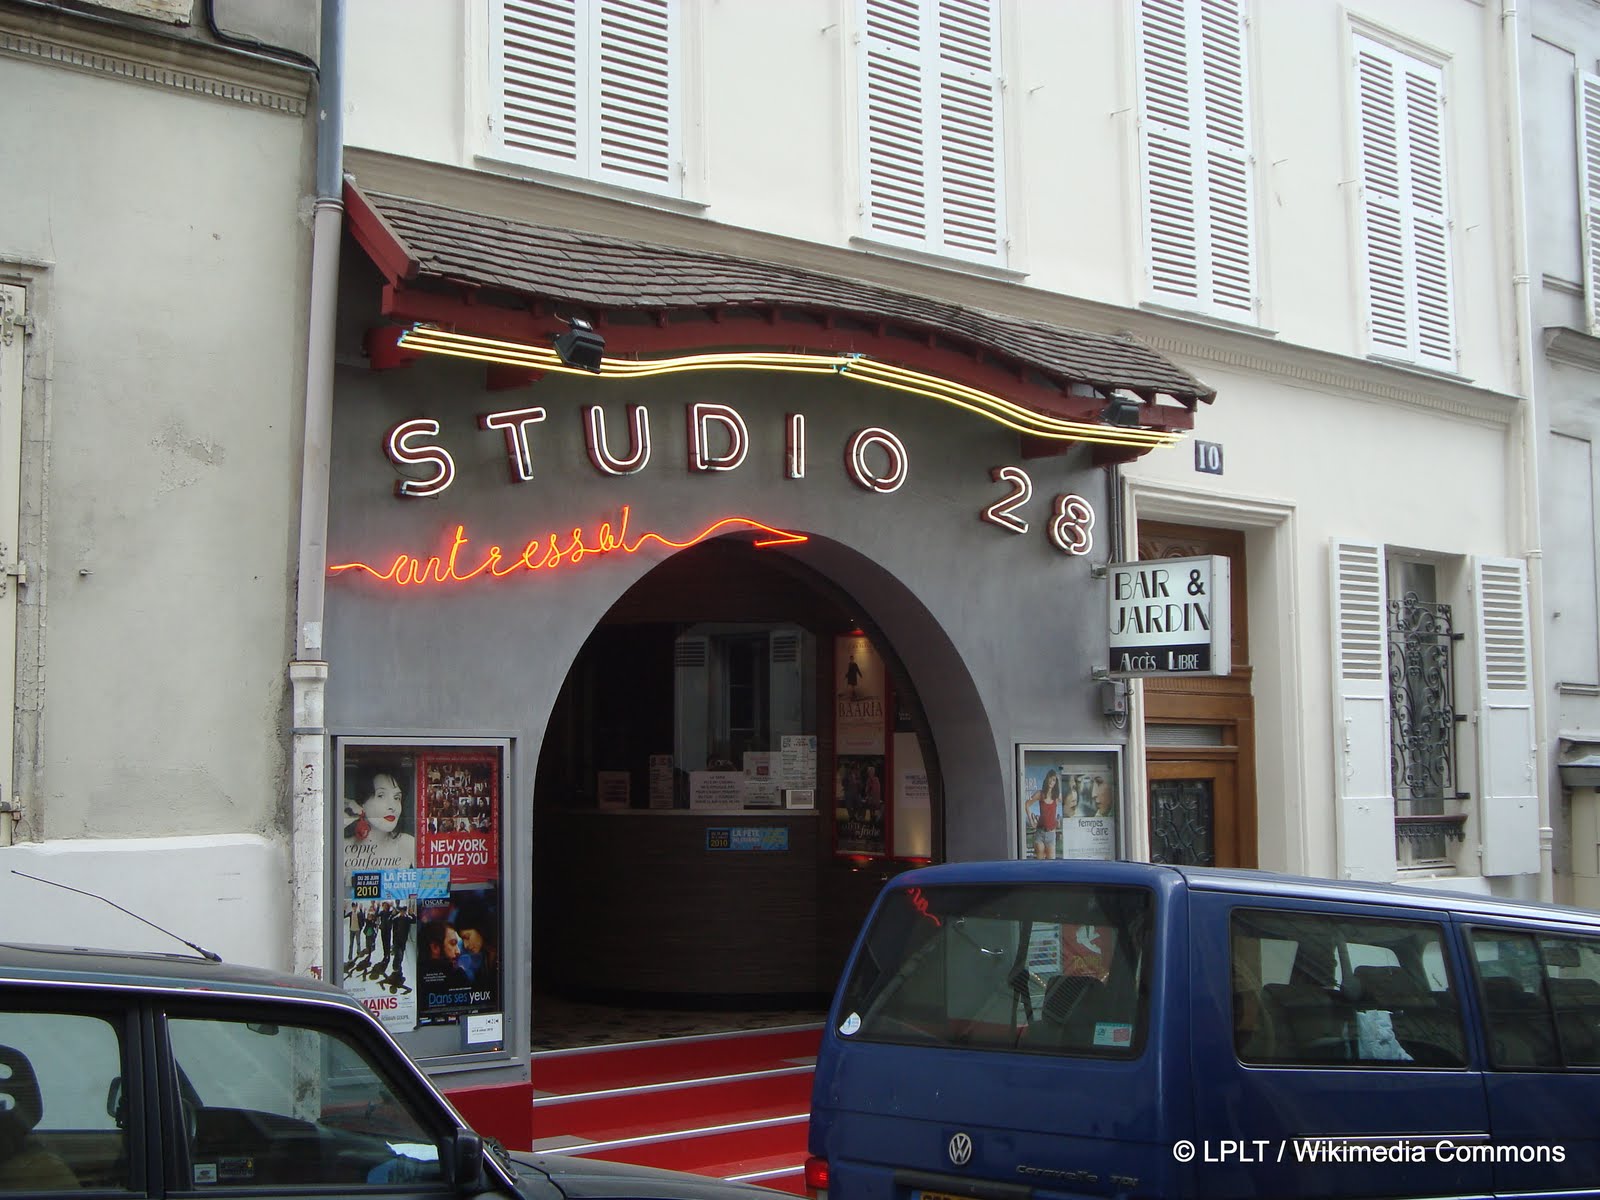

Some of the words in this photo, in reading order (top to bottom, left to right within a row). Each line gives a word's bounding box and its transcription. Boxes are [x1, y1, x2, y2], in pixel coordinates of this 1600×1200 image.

[1199, 443, 1220, 470] 10
[386, 403, 910, 500] STUDIO
[980, 465, 1096, 557] 28
[1115, 569, 1170, 600] BAR
[1187, 568, 1206, 596] &
[1109, 602, 1211, 635] JARDIN
[344, 843, 378, 857] copie
[430, 839, 457, 853] NEW
[710, 839, 728, 848] 2010
[344, 855, 402, 869] conforme
[430, 853, 434, 866] I
[436, 853, 466, 866] LOVE
[466, 852, 489, 865] YOU
[384, 872, 395, 882] LA
[356, 886, 378, 896] 2010
[428, 992, 454, 1005] Dans
[454, 992, 468, 1003] ses
[469, 990, 491, 1004] yeux
